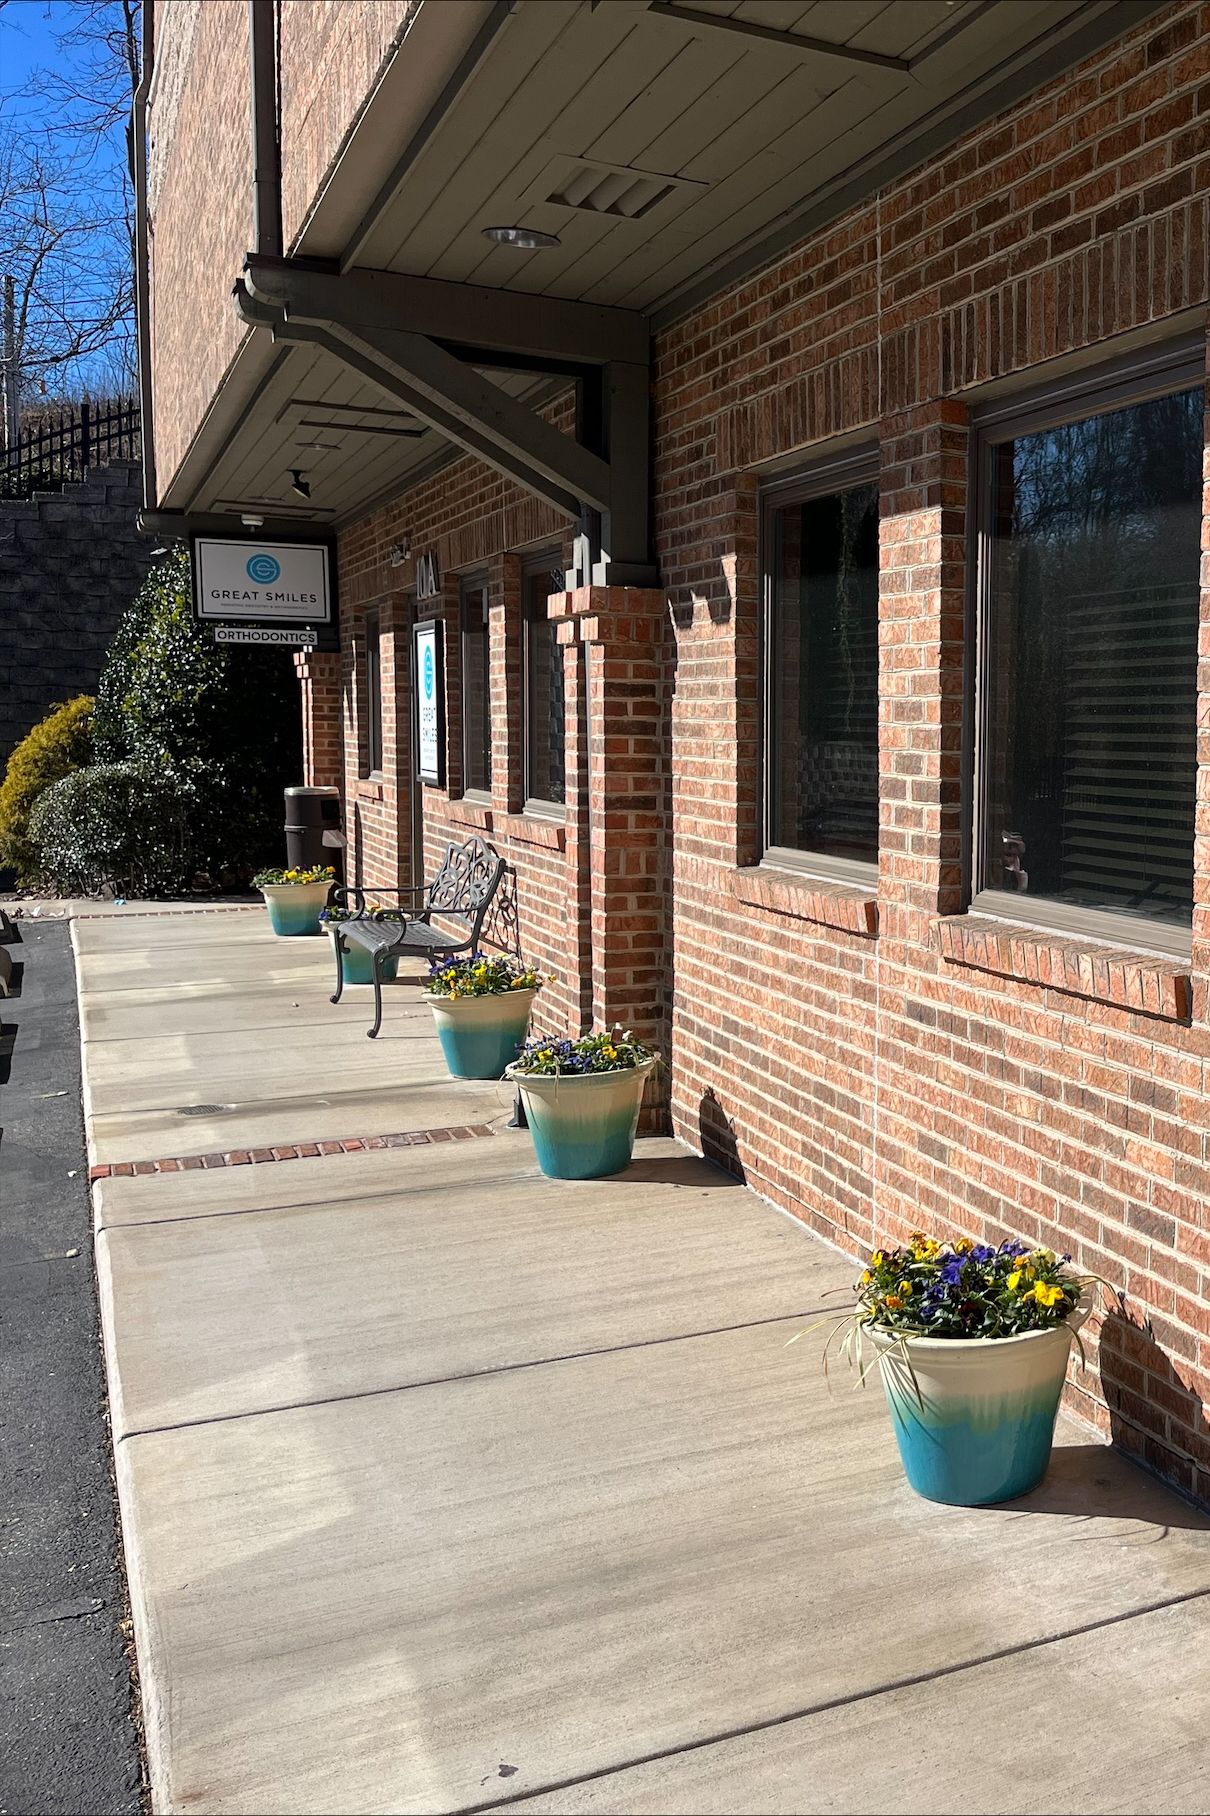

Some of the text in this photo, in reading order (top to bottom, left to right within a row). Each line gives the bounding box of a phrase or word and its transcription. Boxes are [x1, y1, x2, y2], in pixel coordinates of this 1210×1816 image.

[211, 589, 318, 603] GREAT SMILES
[217, 630, 316, 643] ORTHODONTICS
